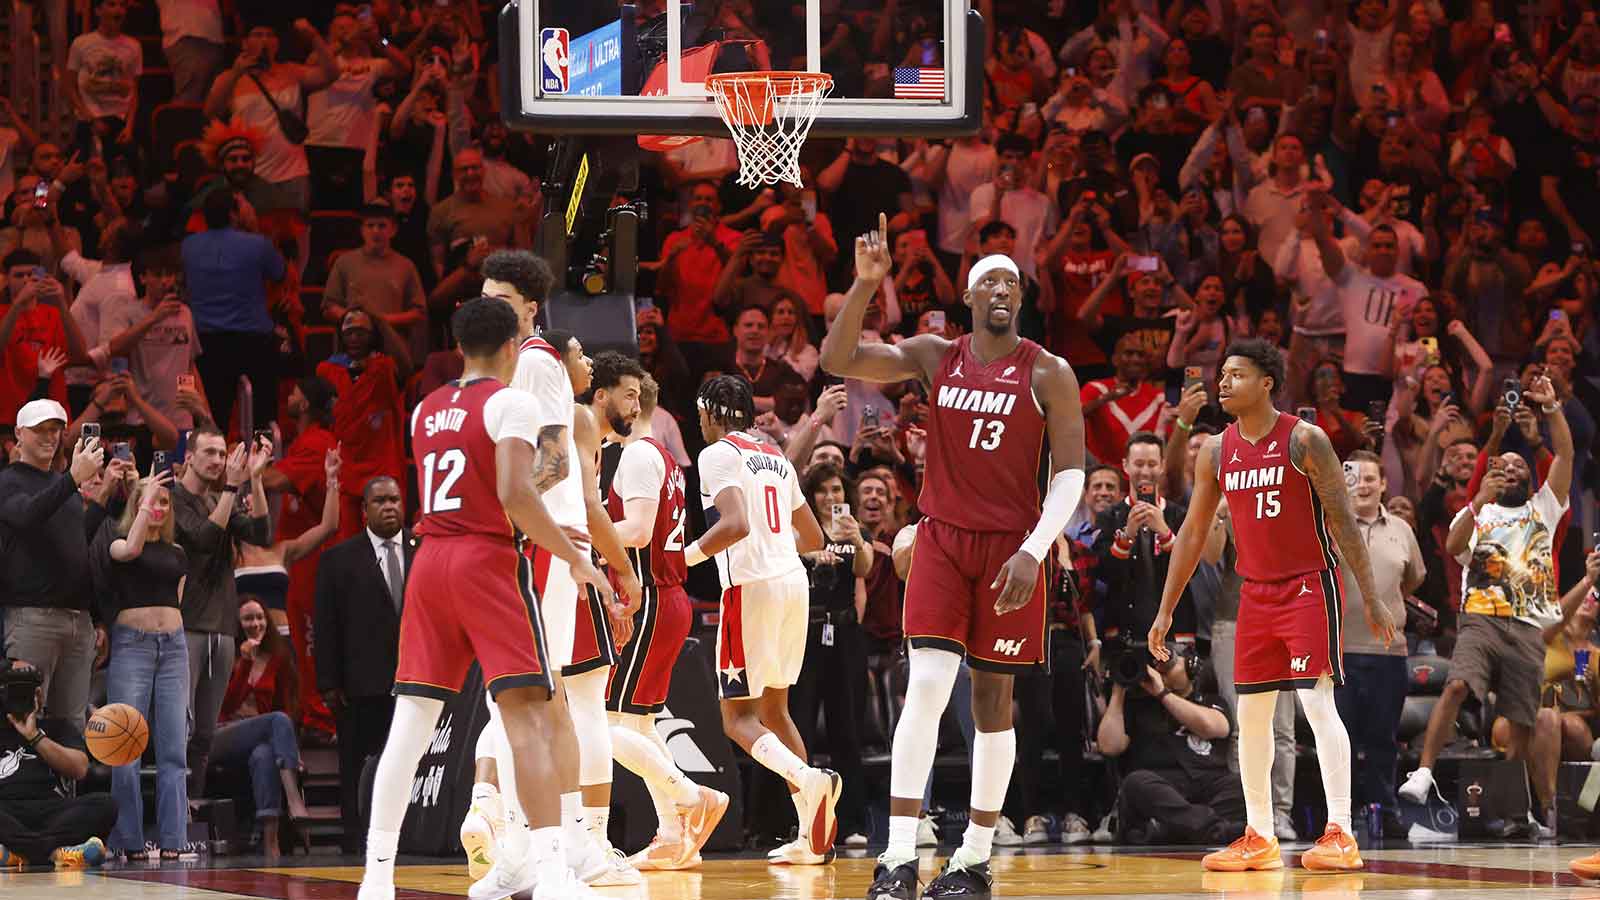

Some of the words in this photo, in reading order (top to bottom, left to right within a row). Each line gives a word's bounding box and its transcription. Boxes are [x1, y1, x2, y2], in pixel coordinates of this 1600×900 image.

[594, 37, 620, 67] ULTRA
[545, 79, 559, 89] NBA
[937, 385, 1017, 415] MIAMI
[424, 407, 468, 437] SMITH
[968, 418, 1006, 451] 13
[423, 448, 466, 515] 12
[745, 455, 789, 480] COULIBALY
[1225, 466, 1284, 491] MIAMI
[764, 485, 781, 534] 0
[1255, 490, 1281, 519] 15
